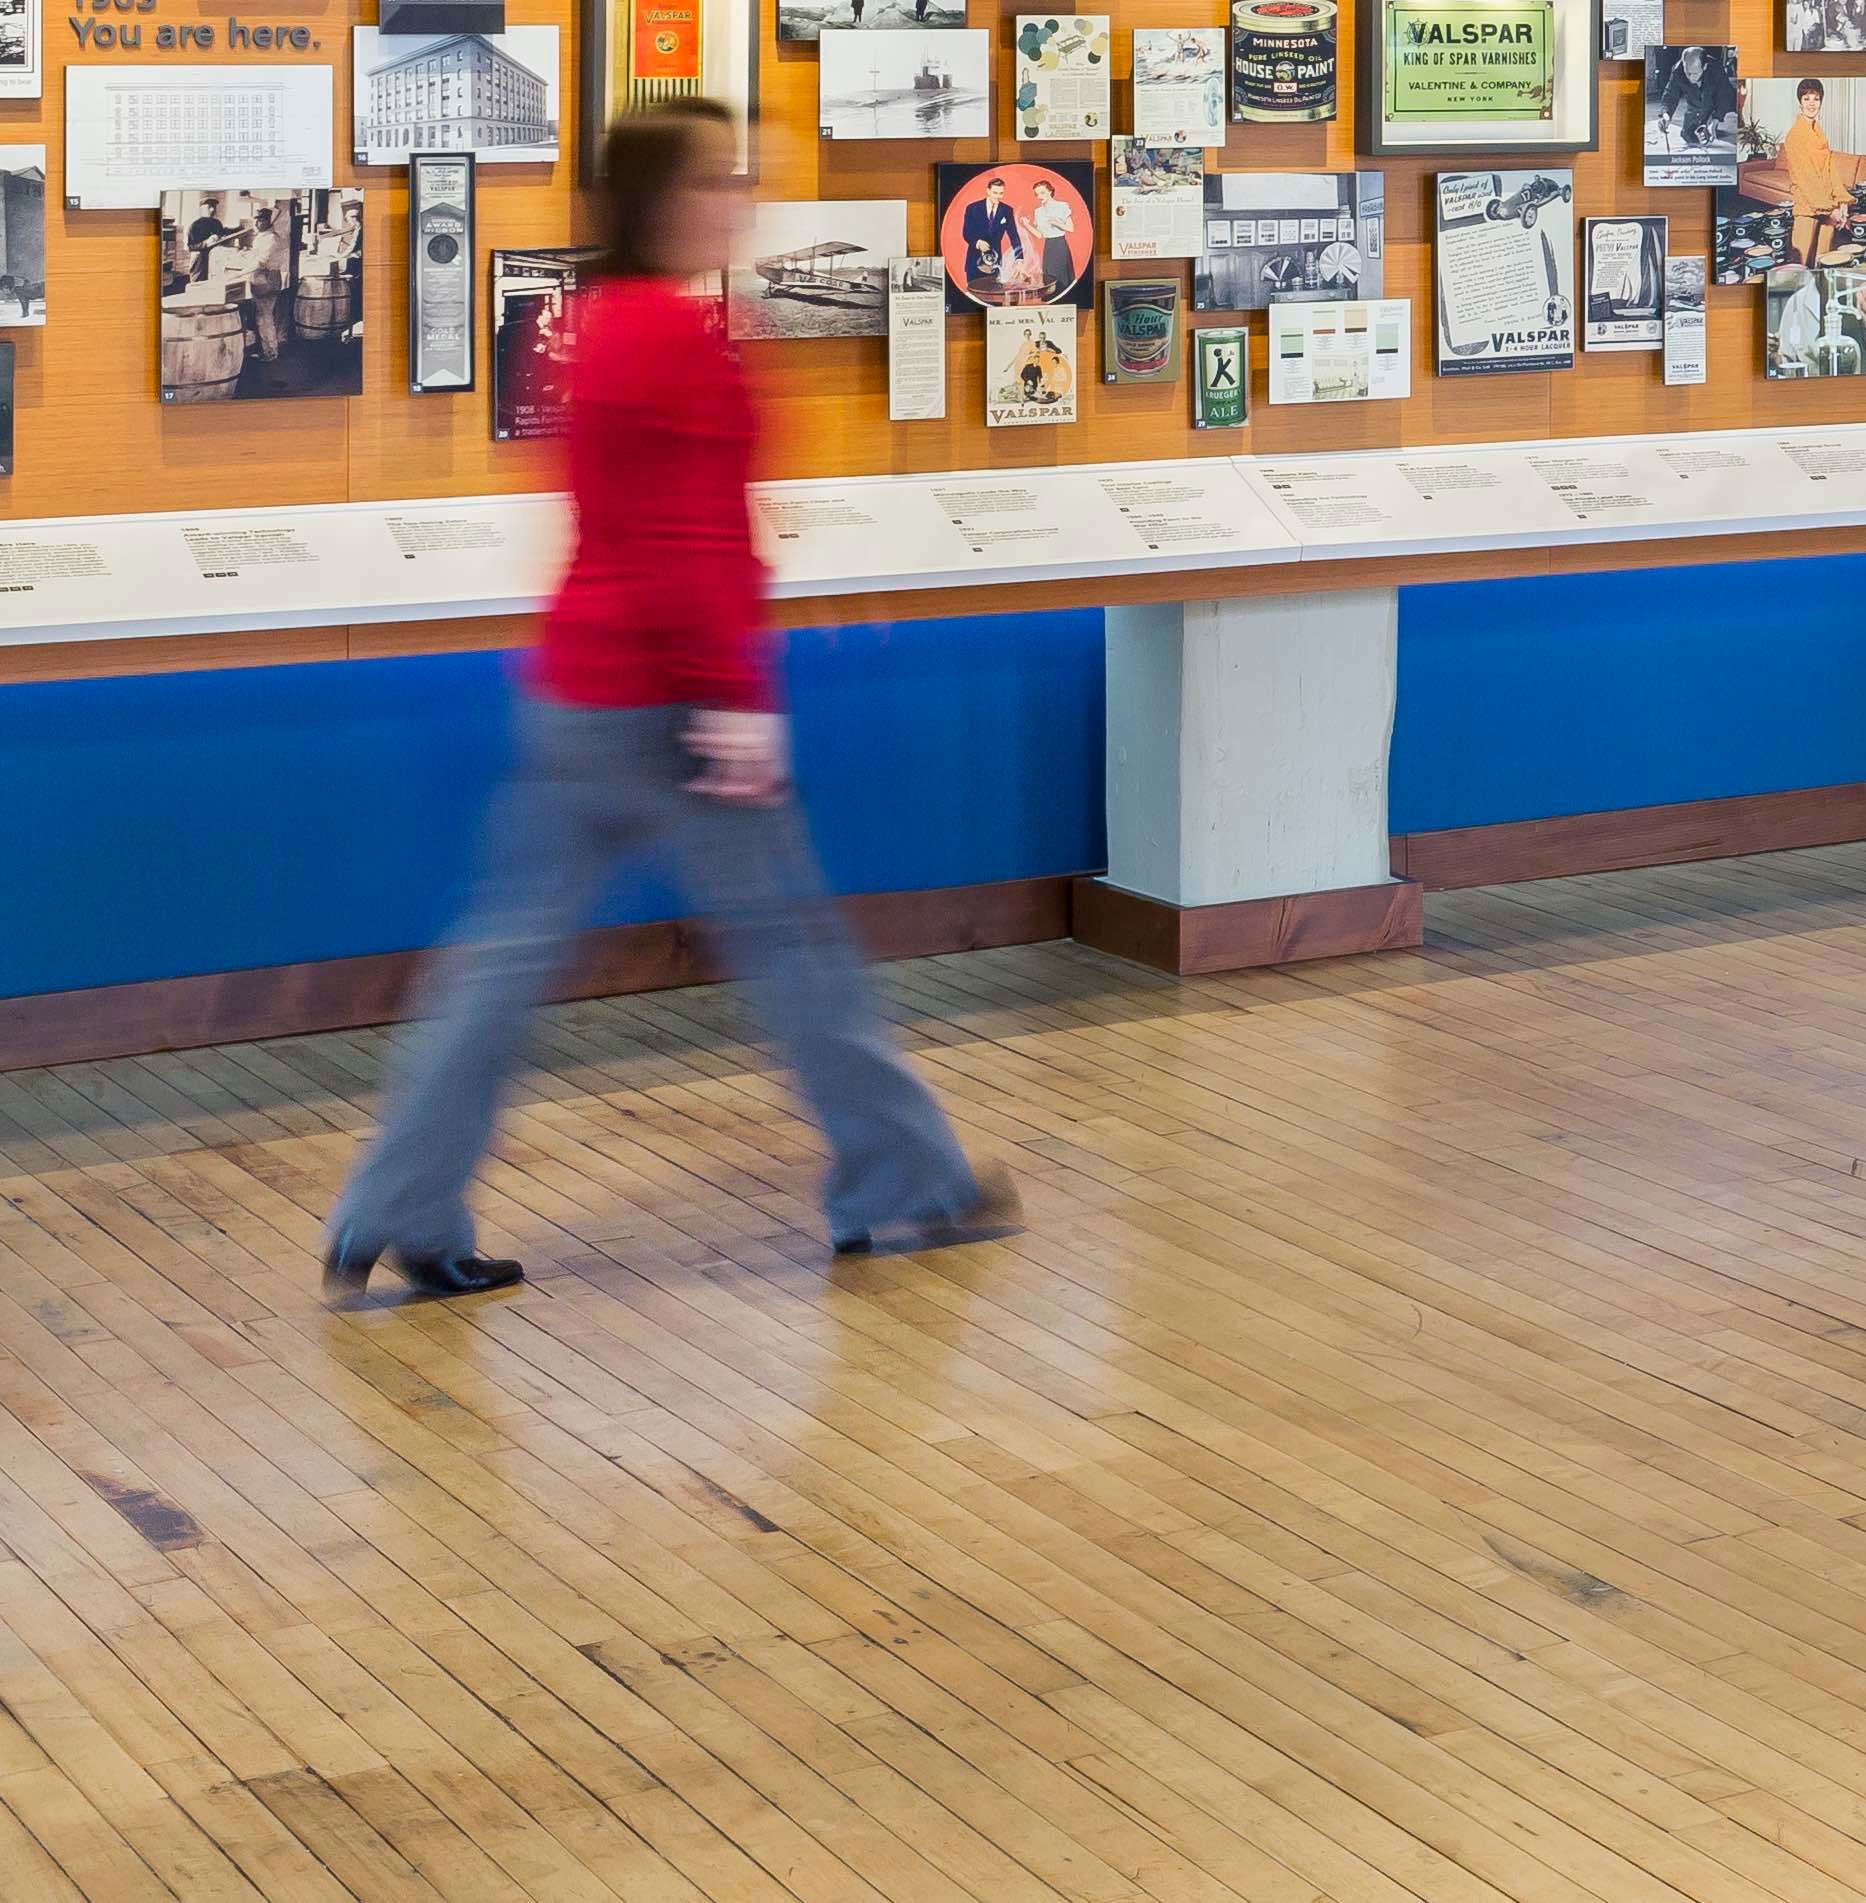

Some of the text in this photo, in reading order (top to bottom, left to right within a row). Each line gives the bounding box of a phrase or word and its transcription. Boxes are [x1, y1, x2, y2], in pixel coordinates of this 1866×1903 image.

[644, 10, 691, 24] VALSPAR
[69, 17, 321, 50] You are here.
[1407, 22, 1533, 45] VALSPAR
[1253, 38, 1318, 48] MINNESOTA
[1403, 51, 1537, 66] KING OF SPAR VARNISHES
[1235, 57, 1334, 79] HOUSE PAINT
[1409, 81, 1531, 91] VALENTINE & COMPANY
[1119, 242, 1156, 256] VALSPAR
[1492, 330, 1570, 352] VALSPAR
[990, 407, 1072, 423] VALSPAR
[1210, 405, 1239, 418] ALE
